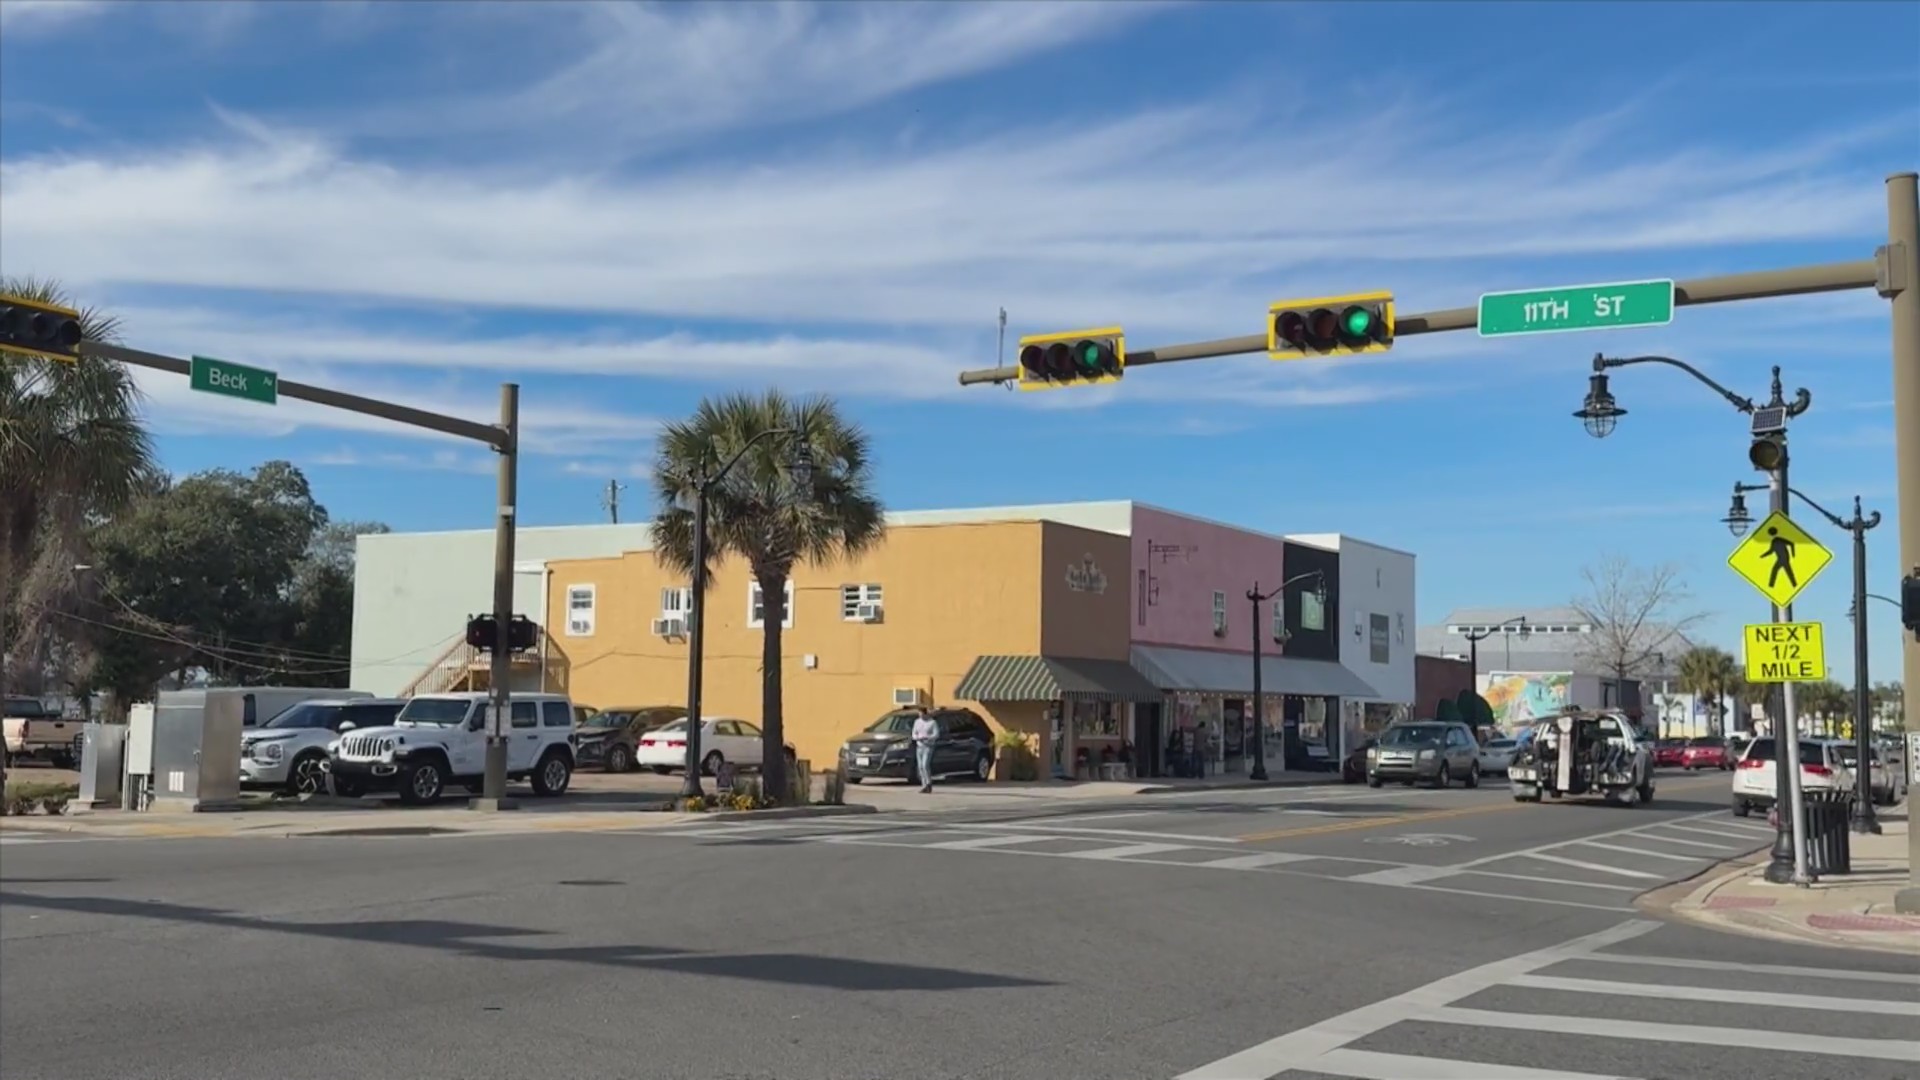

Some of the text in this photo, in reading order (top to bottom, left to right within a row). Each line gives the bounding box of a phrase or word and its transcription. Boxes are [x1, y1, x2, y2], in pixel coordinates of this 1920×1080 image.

[1524, 295, 1625, 322] 11TH ST
[209, 367, 247, 391] Beck
[1756, 625, 1812, 642] NEXT
[1772, 644, 1800, 660] 1/2
[1761, 661, 1813, 677] MILE
